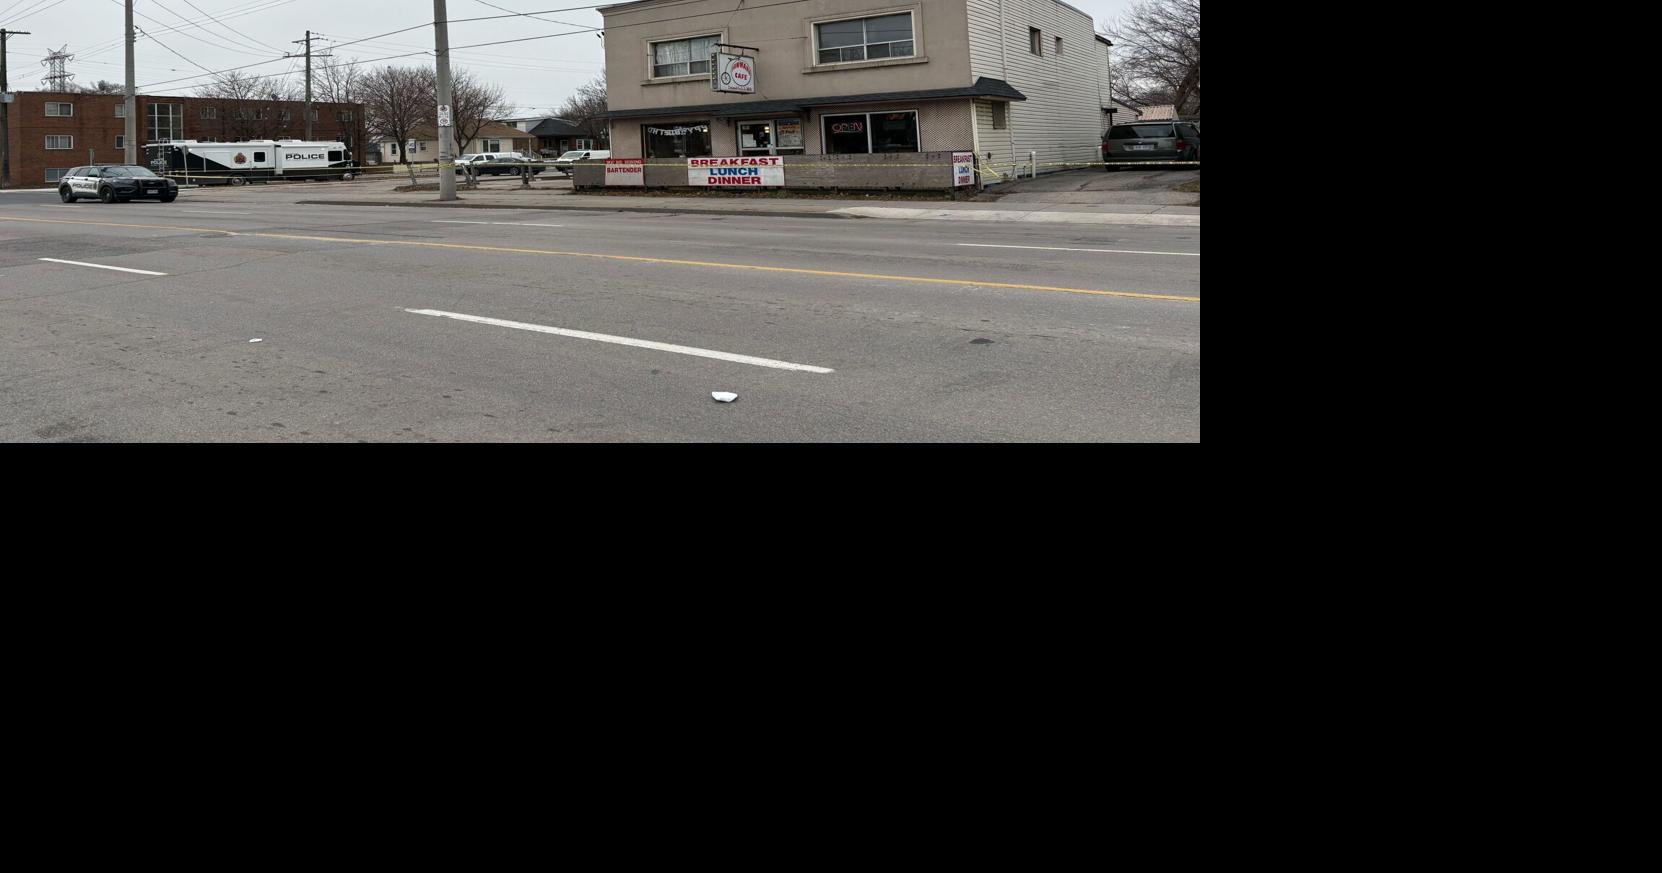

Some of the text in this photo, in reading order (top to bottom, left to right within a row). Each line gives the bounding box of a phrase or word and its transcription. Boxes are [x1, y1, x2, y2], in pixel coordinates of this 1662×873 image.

[735, 72, 748, 80] CAFE
[832, 122, 864, 133] OPEN
[691, 158, 779, 167] BREAKFAST
[709, 167, 758, 176] LUNCH
[708, 176, 761, 185] DINNER
